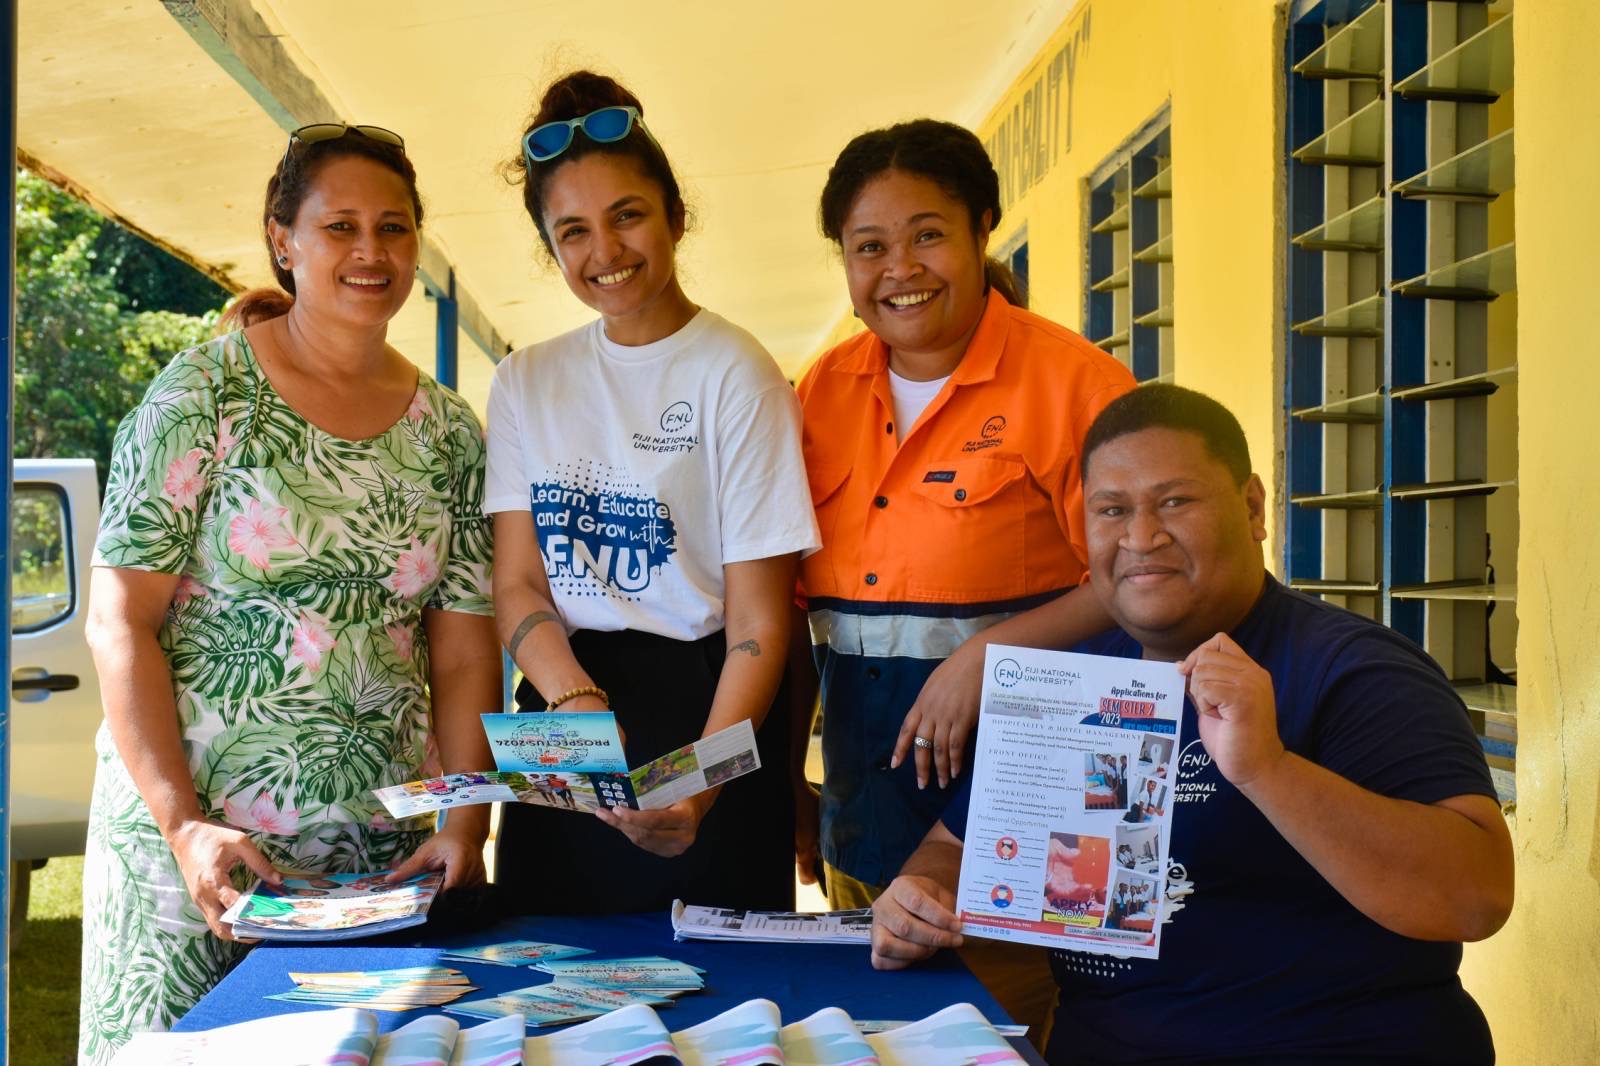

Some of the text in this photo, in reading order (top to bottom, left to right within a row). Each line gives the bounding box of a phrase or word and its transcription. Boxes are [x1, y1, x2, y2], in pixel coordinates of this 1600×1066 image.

[666, 413, 693, 425] FNU
[632, 433, 699, 444] FIJI NATIONAL
[633, 442, 694, 453] UNIVERSITY
[531, 487, 669, 519] Learn, Educate
[537, 510, 672, 554] and Grow with
[546, 534, 650, 591] FNU
[1000, 669, 1023, 680] FNU
[1025, 667, 1081, 679] FIJI NATIONAL
[1024, 675, 1073, 687] UNIVERSITY
[1131, 680, 1145, 688] New
[1111, 687, 1167, 700] Applications for
[1100, 712, 1120, 725] 2023
[495, 739, 611, 747] PROSPECTUS 2024
[1182, 754, 1211, 766] FNU
[1175, 782, 1217, 792] ATIONAL
[1173, 793, 1210, 803] ERSITY
[1049, 897, 1093, 910] APPLY
[1056, 909, 1086, 919] NOW
